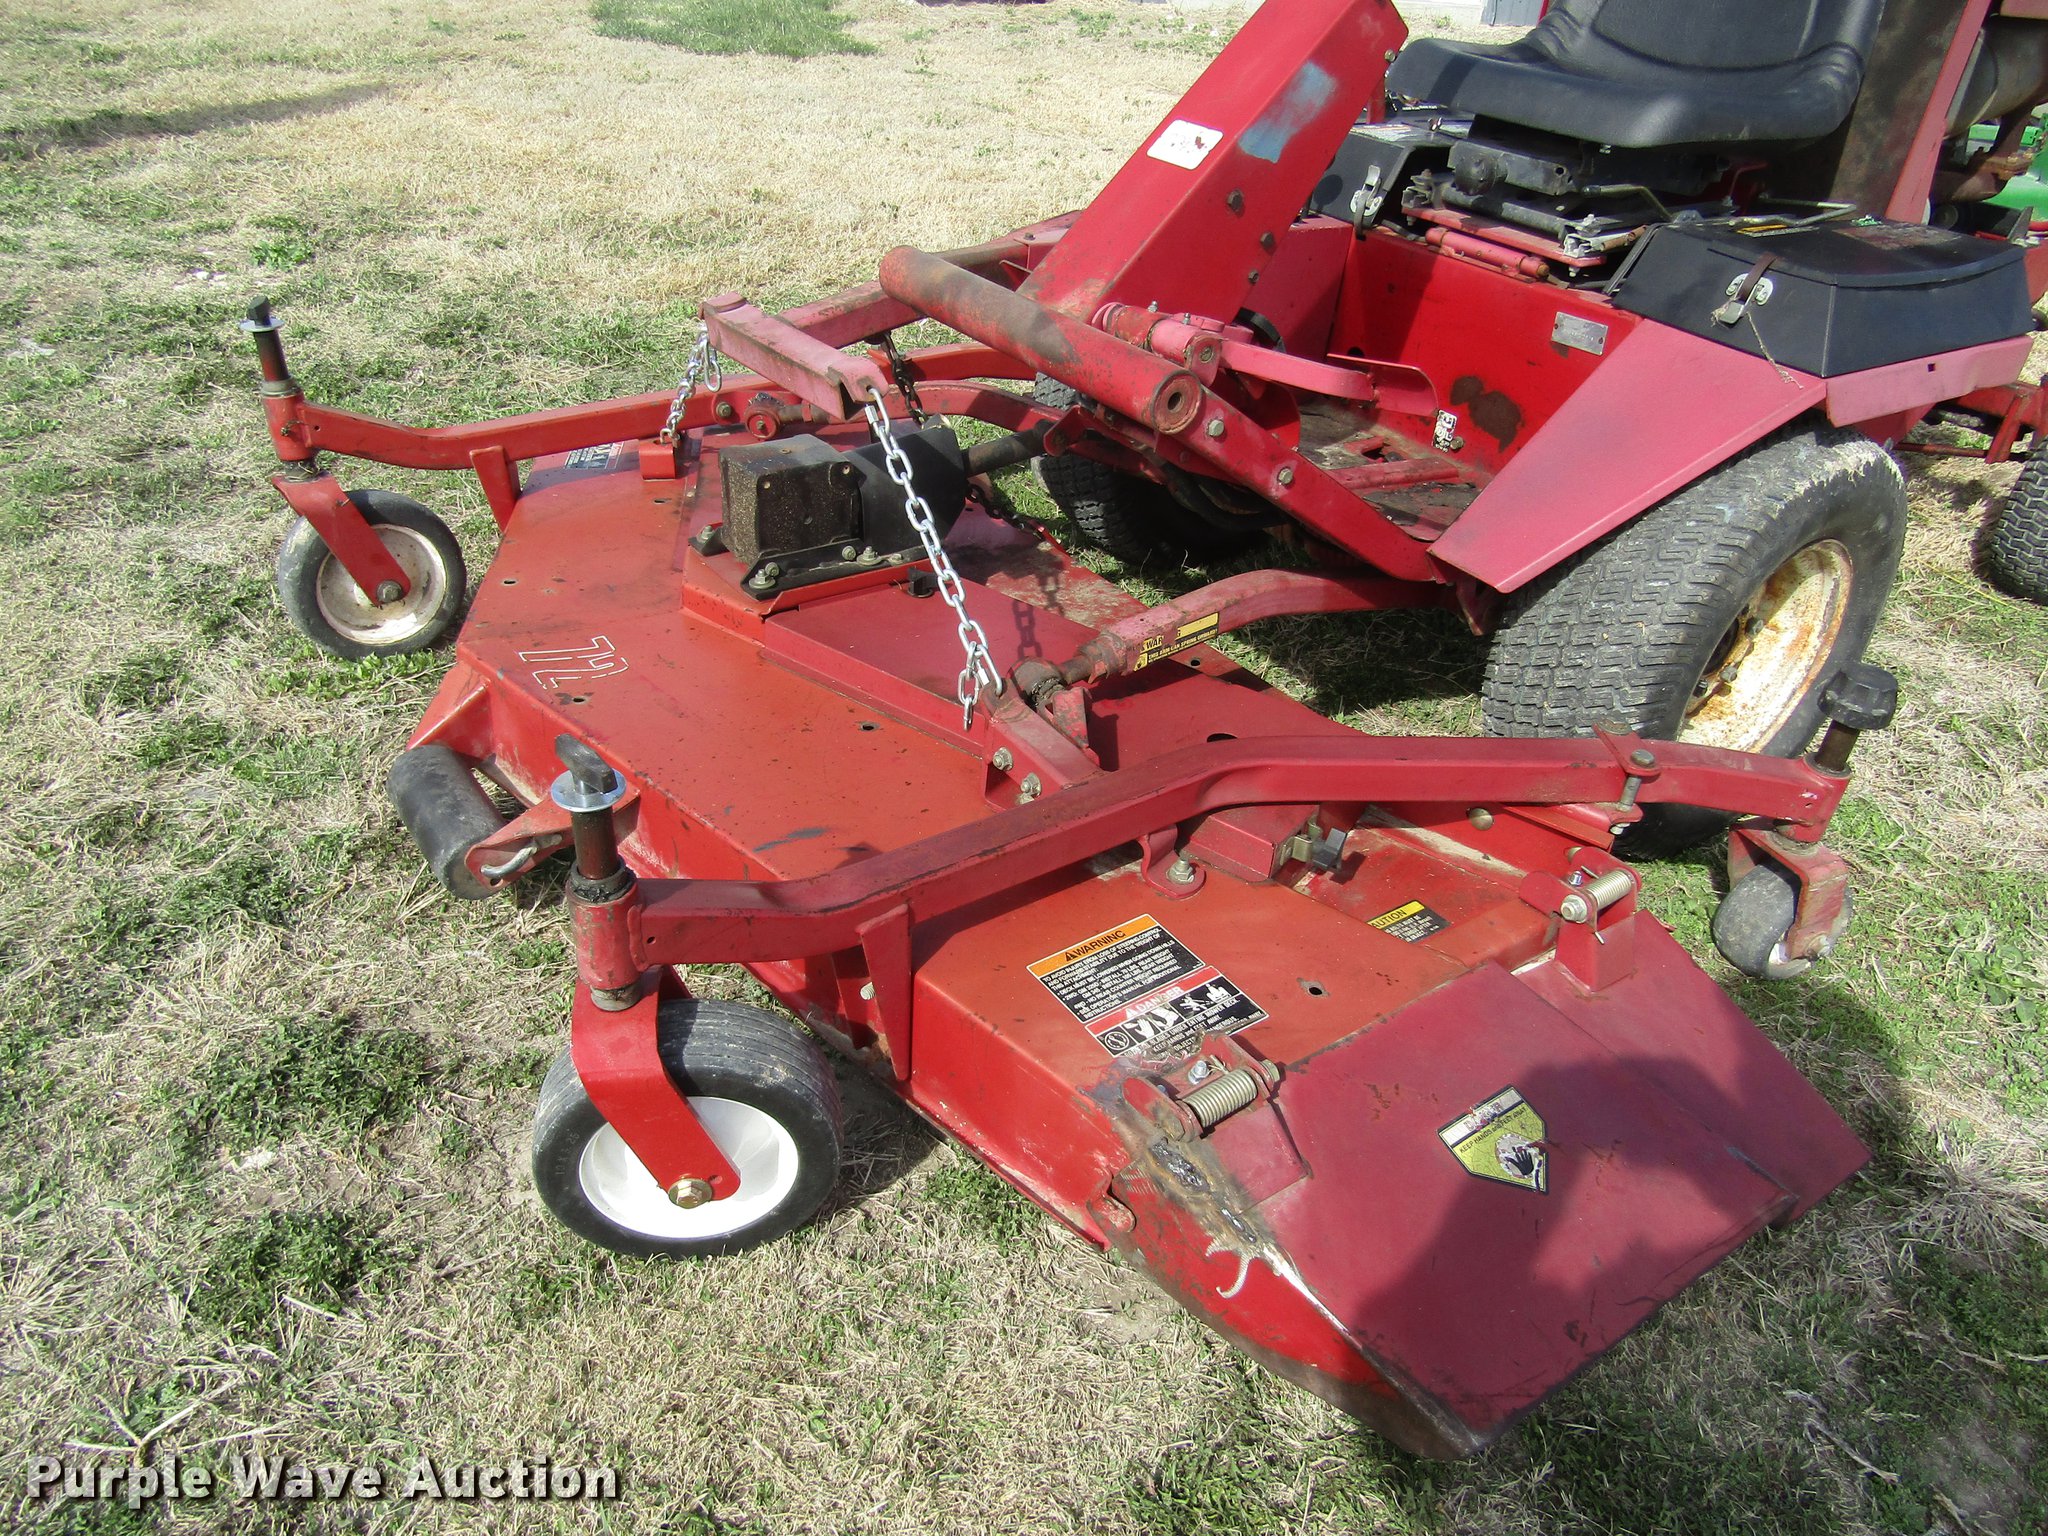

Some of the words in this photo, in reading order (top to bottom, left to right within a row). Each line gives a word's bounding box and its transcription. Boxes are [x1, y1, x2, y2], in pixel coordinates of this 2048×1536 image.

[518, 635, 629, 690] 72
[1371, 909, 1407, 927] AUTION
[1073, 930, 1127, 957] WARNING
[1135, 985, 1185, 1013] DANGER
[1149, 1032, 1171, 1045] BLADES
[1169, 1023, 1189, 1036] UNDER
[1186, 1015, 1208, 1027] ENTIRE
[1204, 1005, 1226, 1018] MOWER
[1165, 1032, 1187, 1045] HANDS
[1460, 1141, 1474, 1153] KEEP
[1473, 1129, 1492, 1144] HANDS
